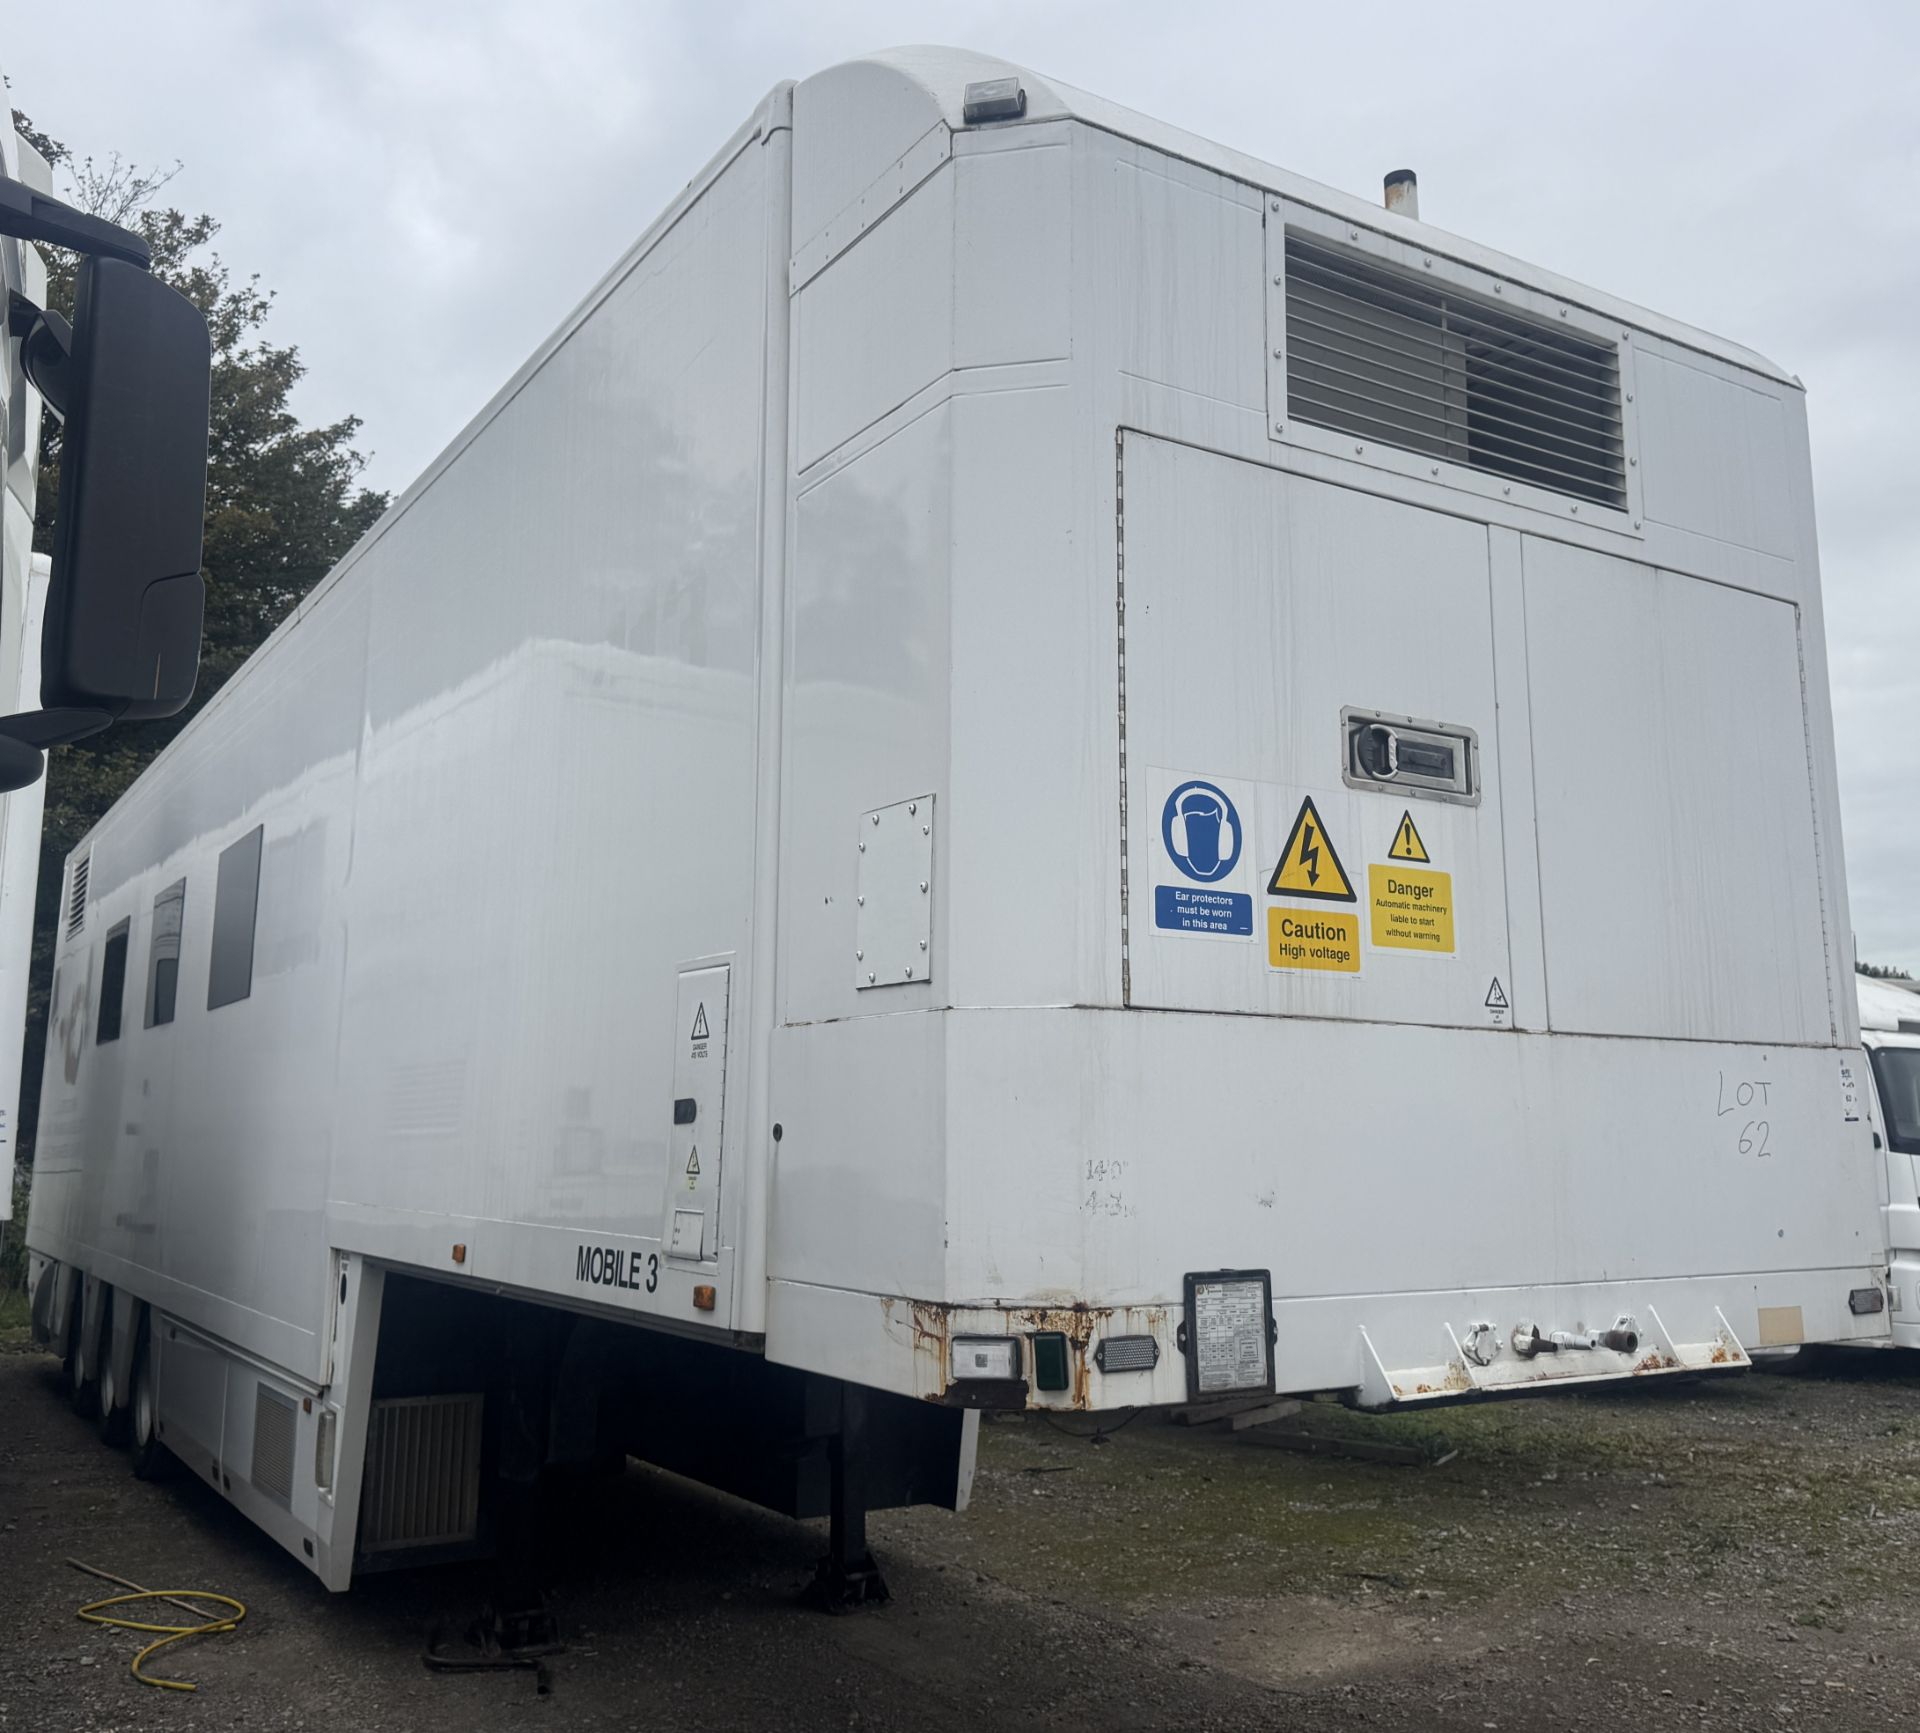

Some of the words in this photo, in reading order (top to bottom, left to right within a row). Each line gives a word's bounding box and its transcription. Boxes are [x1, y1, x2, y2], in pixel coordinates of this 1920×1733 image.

[1175, 891, 1190, 901] Ear
[1191, 894, 1234, 906] protectors
[1387, 879, 1434, 900] Danger
[1177, 906, 1198, 915] must
[1199, 906, 1210, 916] be
[1211, 909, 1233, 918] worn
[1375, 898, 1411, 910] Automatic
[1412, 903, 1448, 915] machinery
[1182, 917, 1190, 927] in
[1192, 918, 1208, 929] this
[1209, 921, 1228, 930] area
[1390, 914, 1409, 924] liable
[1410, 916, 1418, 925] to
[1419, 918, 1435, 926] start
[1281, 918, 1347, 942] Caution
[1385, 928, 1412, 939] without
[1413, 931, 1441, 943] warning
[1279, 943, 1306, 960] High
[1309, 946, 1351, 963] voltage
[1717, 1070, 1772, 1117] LOT
[1738, 1120, 1771, 1157] 62
[576, 1245, 642, 1291] MOBILE
[645, 1253, 658, 1294] 3
